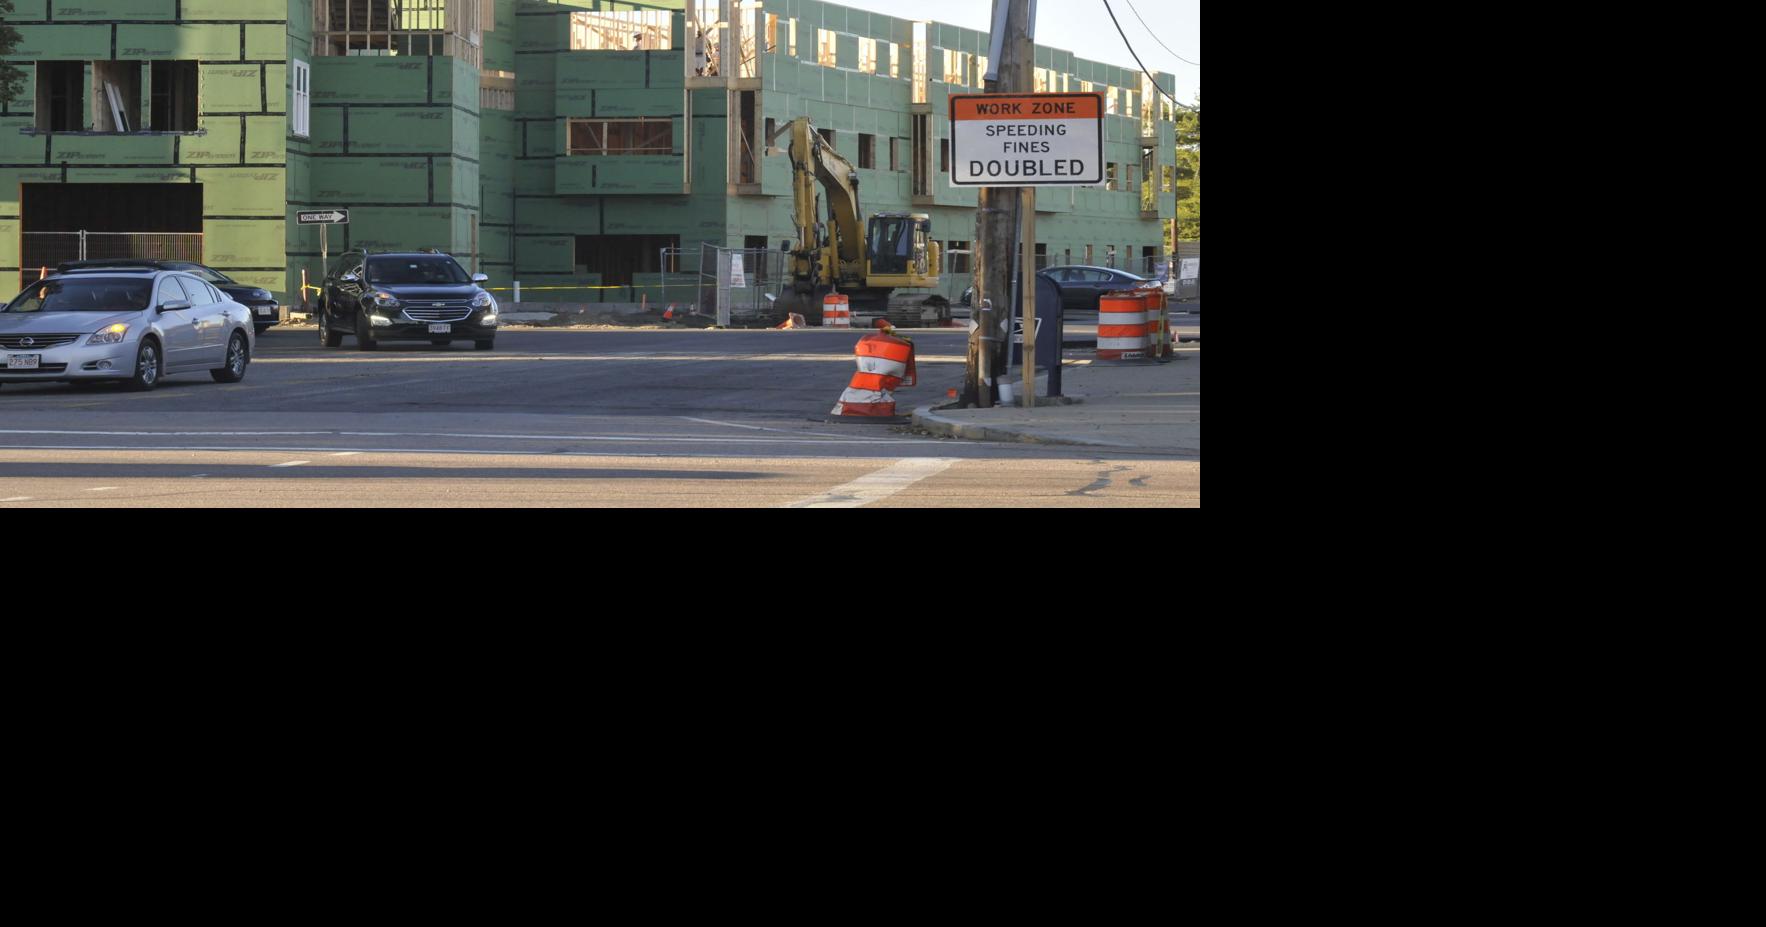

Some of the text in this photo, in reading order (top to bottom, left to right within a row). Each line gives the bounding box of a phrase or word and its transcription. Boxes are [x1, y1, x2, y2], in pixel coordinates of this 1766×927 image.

[976, 102, 1076, 115] WORK ZONE
[985, 124, 1066, 137] SPEEDING
[1003, 141, 1050, 153] FINES
[969, 159, 1085, 177] DOUBLED
